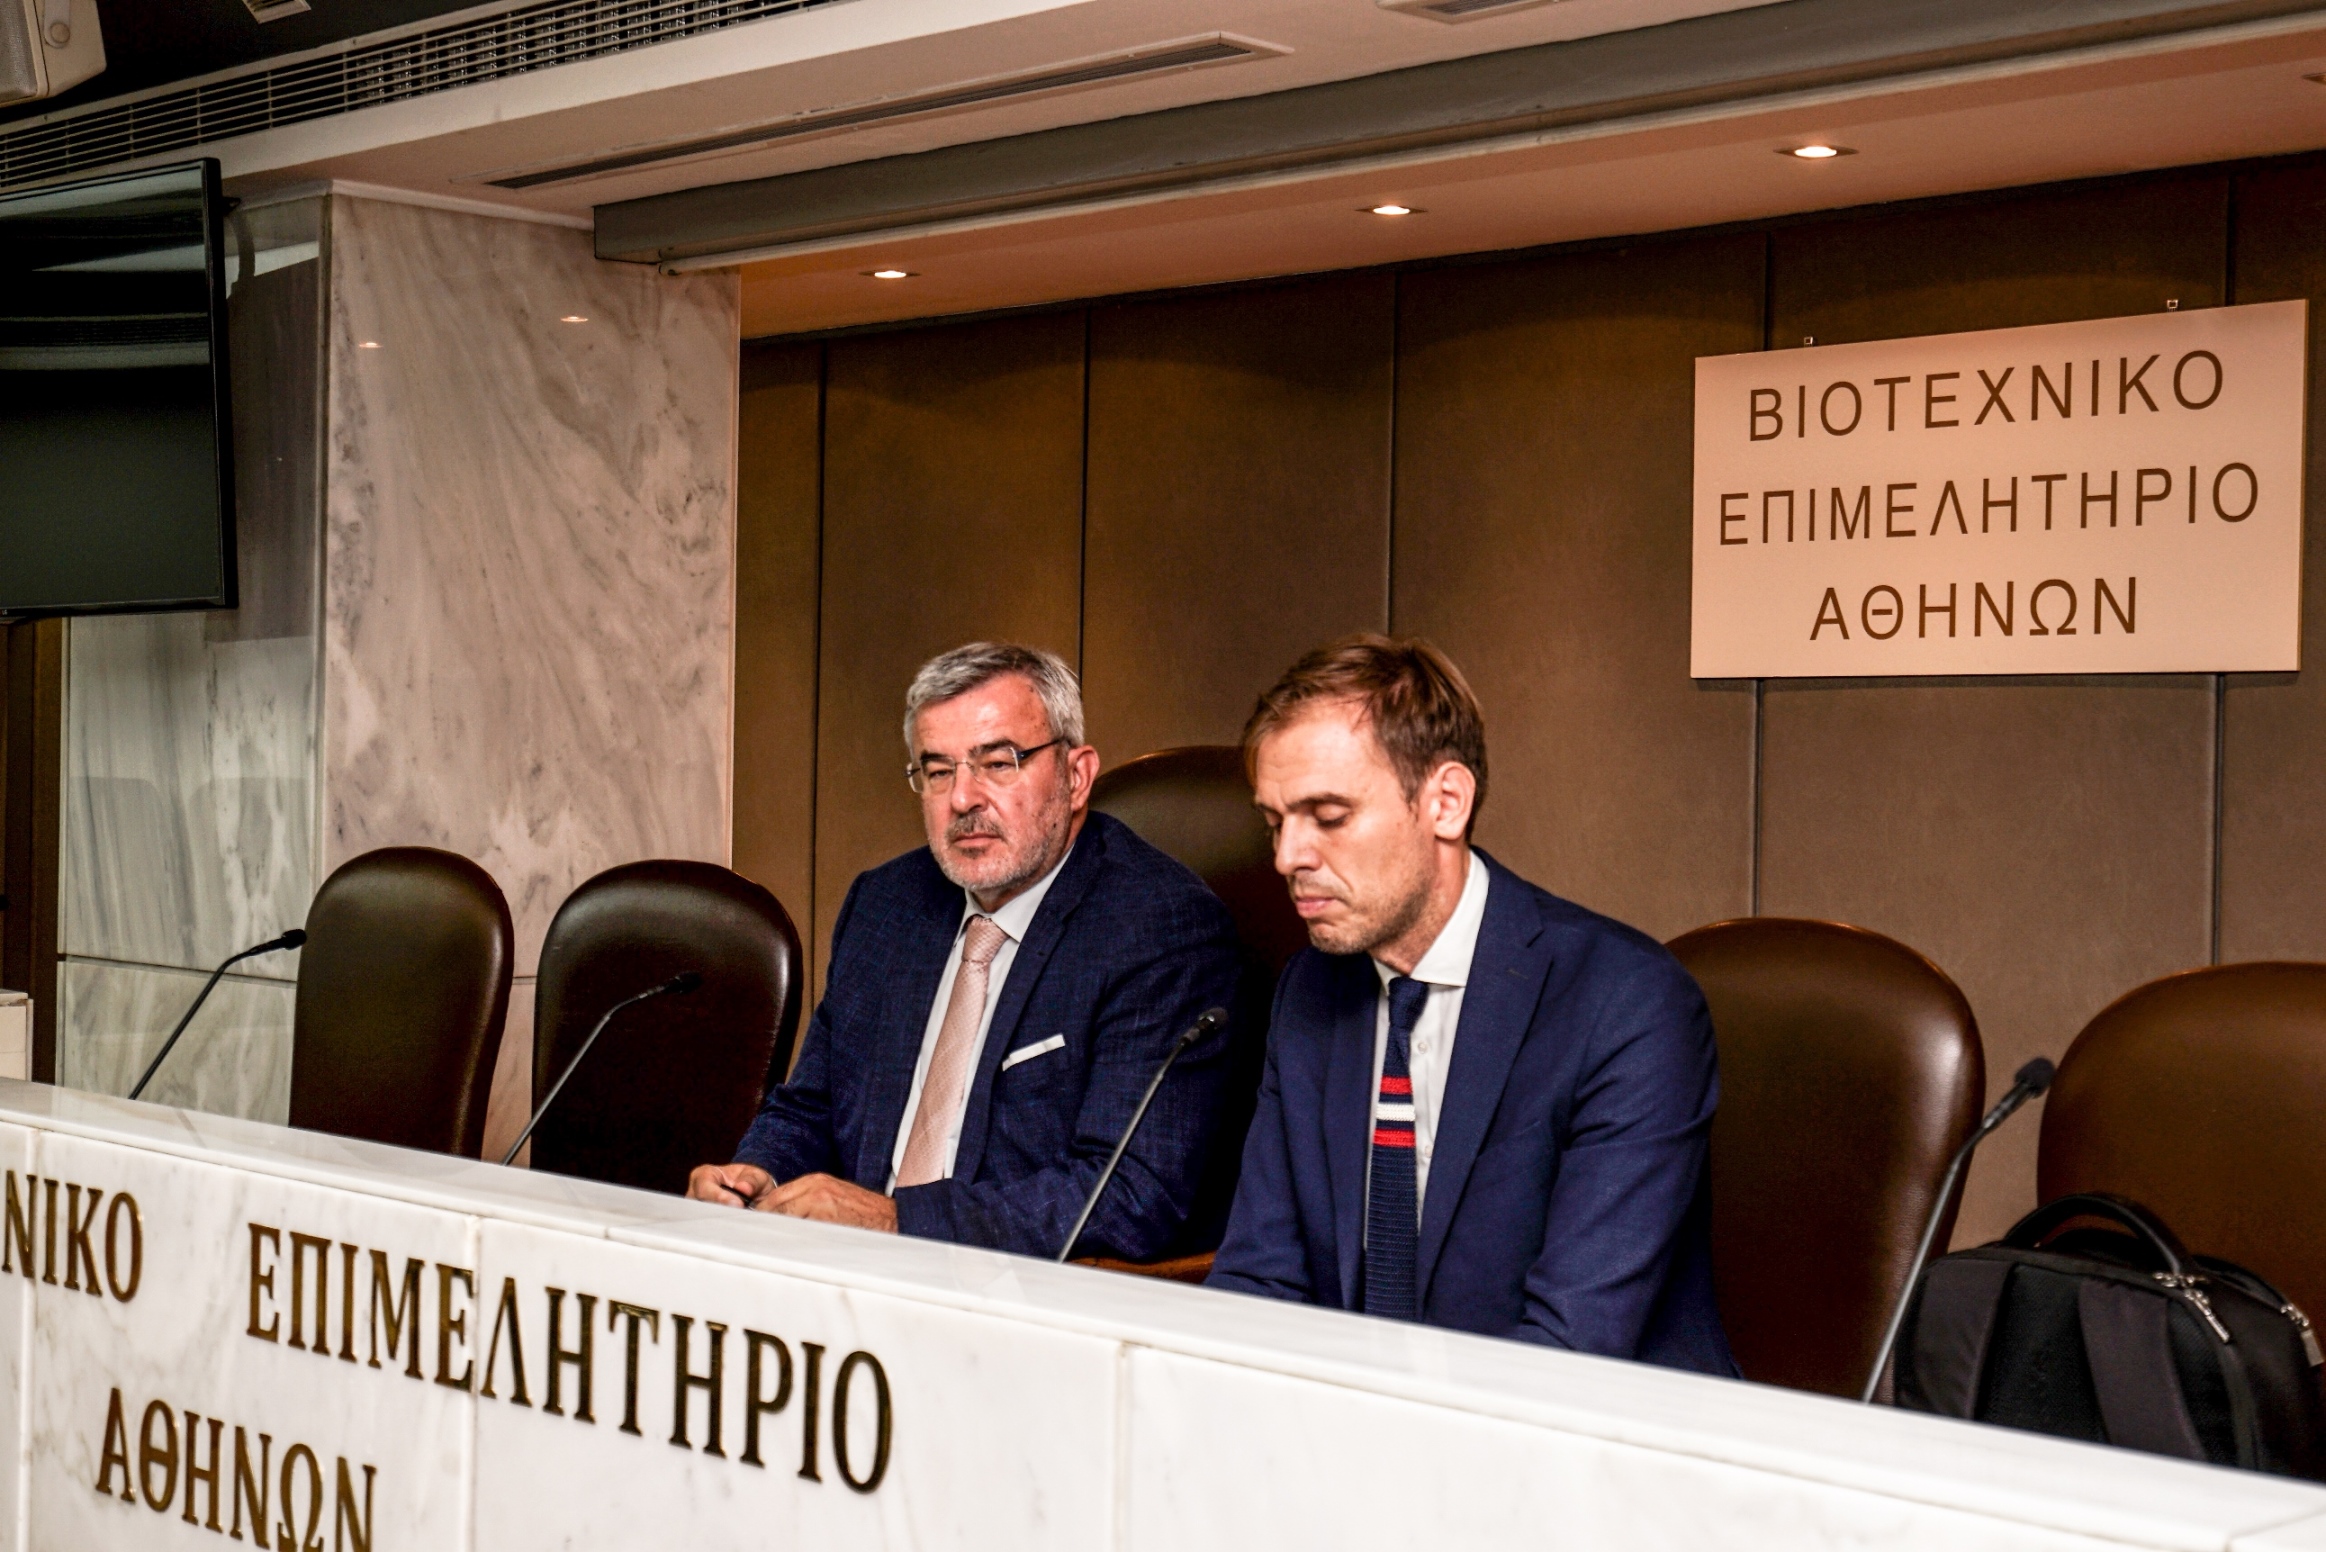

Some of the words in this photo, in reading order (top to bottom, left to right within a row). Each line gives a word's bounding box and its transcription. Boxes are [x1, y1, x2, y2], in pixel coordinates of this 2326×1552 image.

[1748, 349, 2225, 443] ΒΙΟΤΕΧΝΙΚΟ
[1719, 462, 2260, 546] ΕΠΙΜΕΛΗΤΗΡΙΟ
[1809, 576, 2137, 641] ΑΘΗΝΩΝ
[1, 1170, 143, 1303] ΝΙΚΟ
[246, 1222, 893, 1494] ΕΠΙΜΕΛΗΤΗΡΙΟ
[95, 1387, 377, 1552] ΑΘΗΝΩΝ
